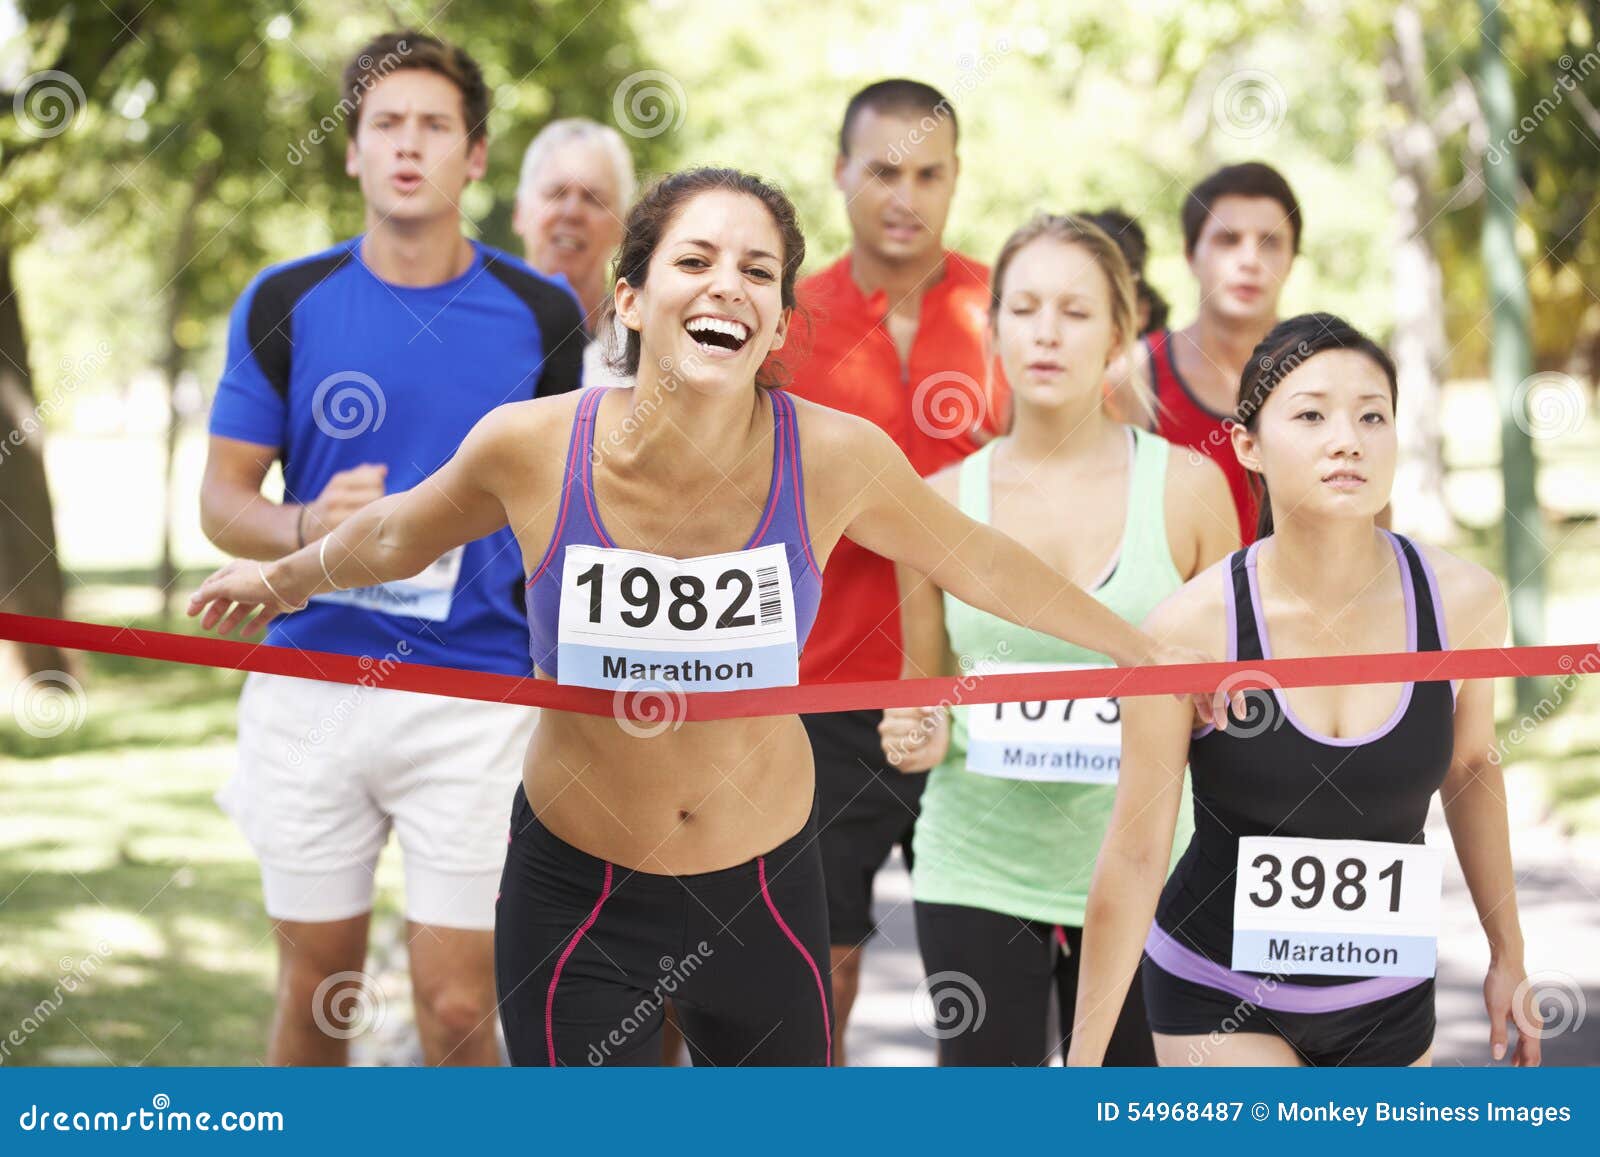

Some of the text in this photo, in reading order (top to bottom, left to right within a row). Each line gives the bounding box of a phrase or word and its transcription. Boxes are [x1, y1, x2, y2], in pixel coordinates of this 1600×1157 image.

[576, 562, 756, 631] 1982
[602, 655, 754, 682] Marathon
[1003, 748, 1121, 771] Marathon
[1249, 853, 1404, 913] 3981
[1268, 938, 1399, 965] Marathon
